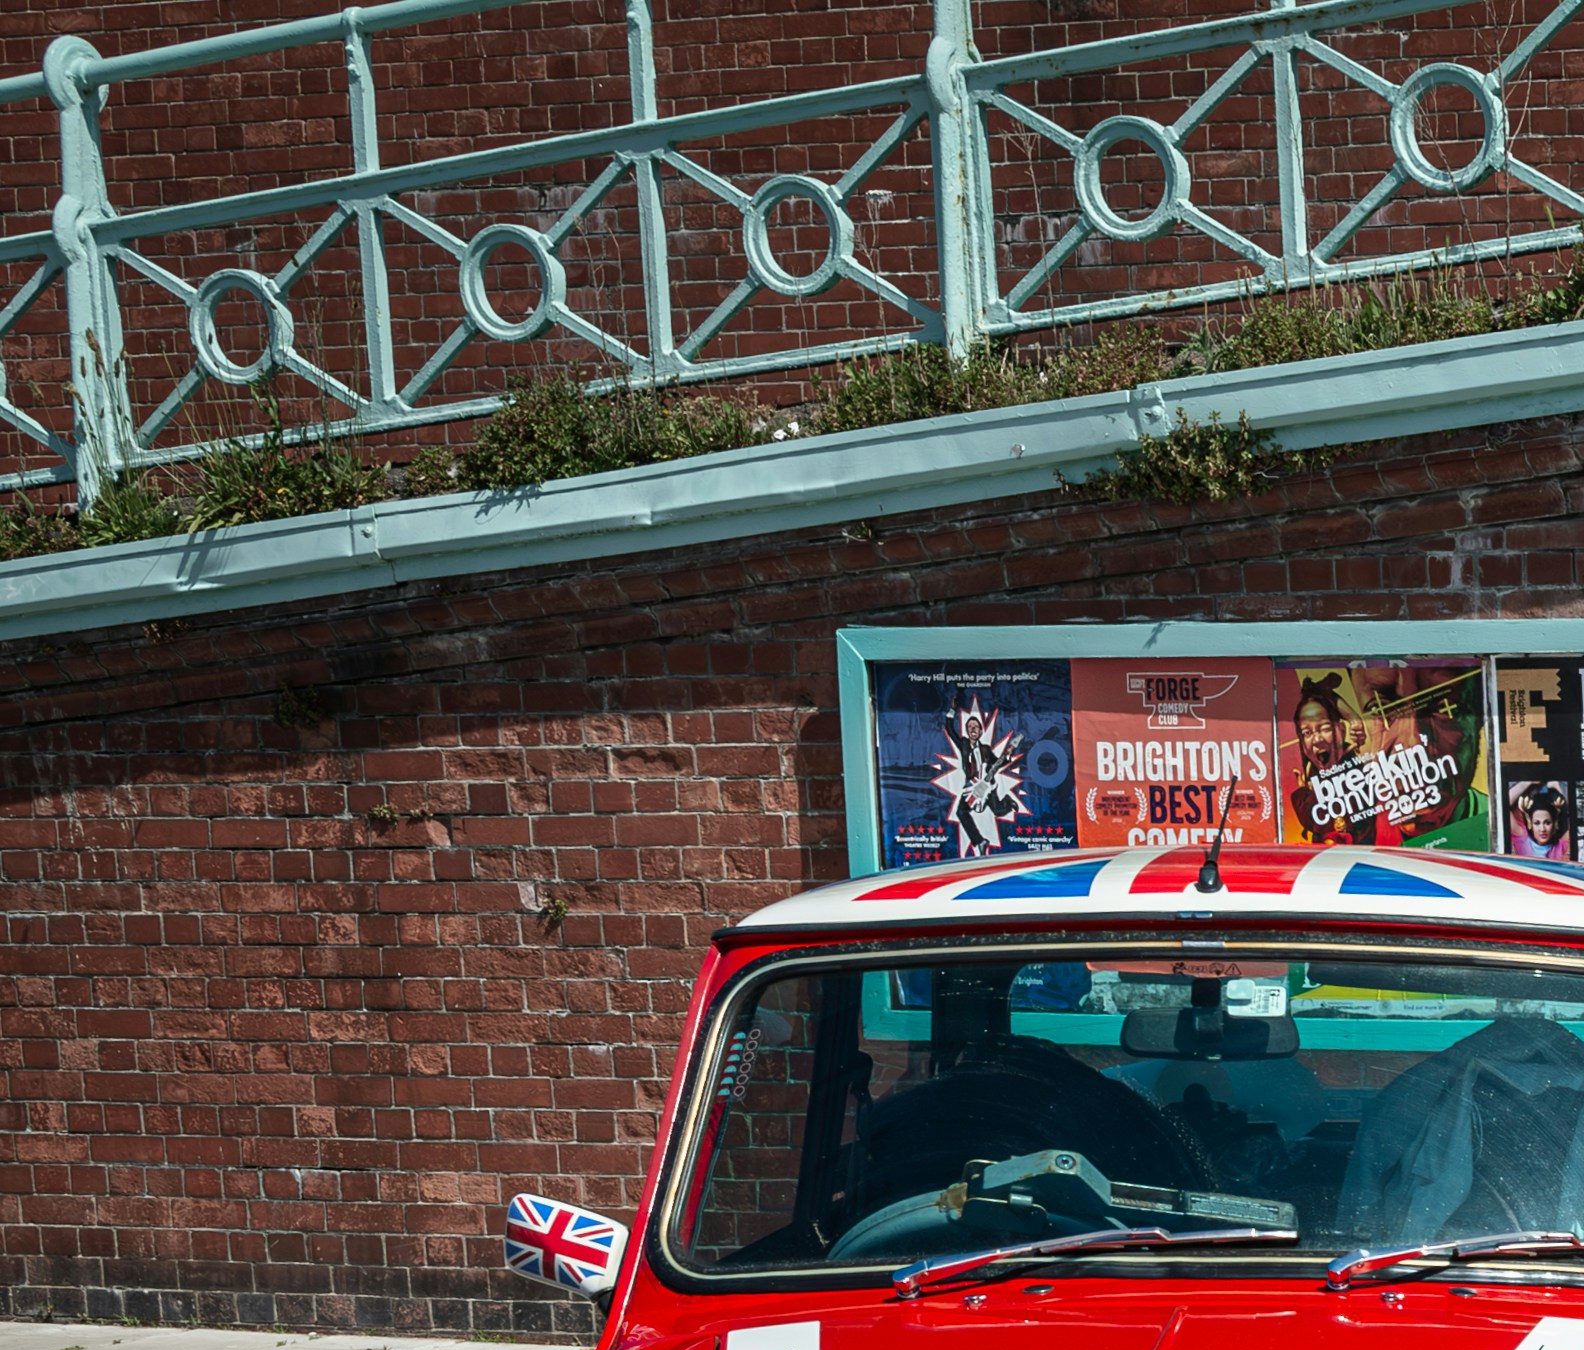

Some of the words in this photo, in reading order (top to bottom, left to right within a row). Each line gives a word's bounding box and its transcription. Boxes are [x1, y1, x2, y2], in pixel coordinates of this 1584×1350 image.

[946, 673, 962, 683] puts
[963, 673, 974, 681] the
[976, 673, 995, 683] party
[997, 672, 1011, 681] into
[1145, 677, 1201, 701] FORGE
[1157, 702, 1189, 714] COMEDY
[1158, 714, 1179, 725] CLUB
[1509, 689, 1518, 726] Festival
[1518, 689, 1526, 728] Brighton
[1096, 740, 1267, 782] BRIGHTON'S
[1309, 733, 1429, 804] breakin'
[1148, 785, 1217, 825] BEST
[1311, 754, 1459, 826] convention
[1384, 784, 1442, 822] 2023
